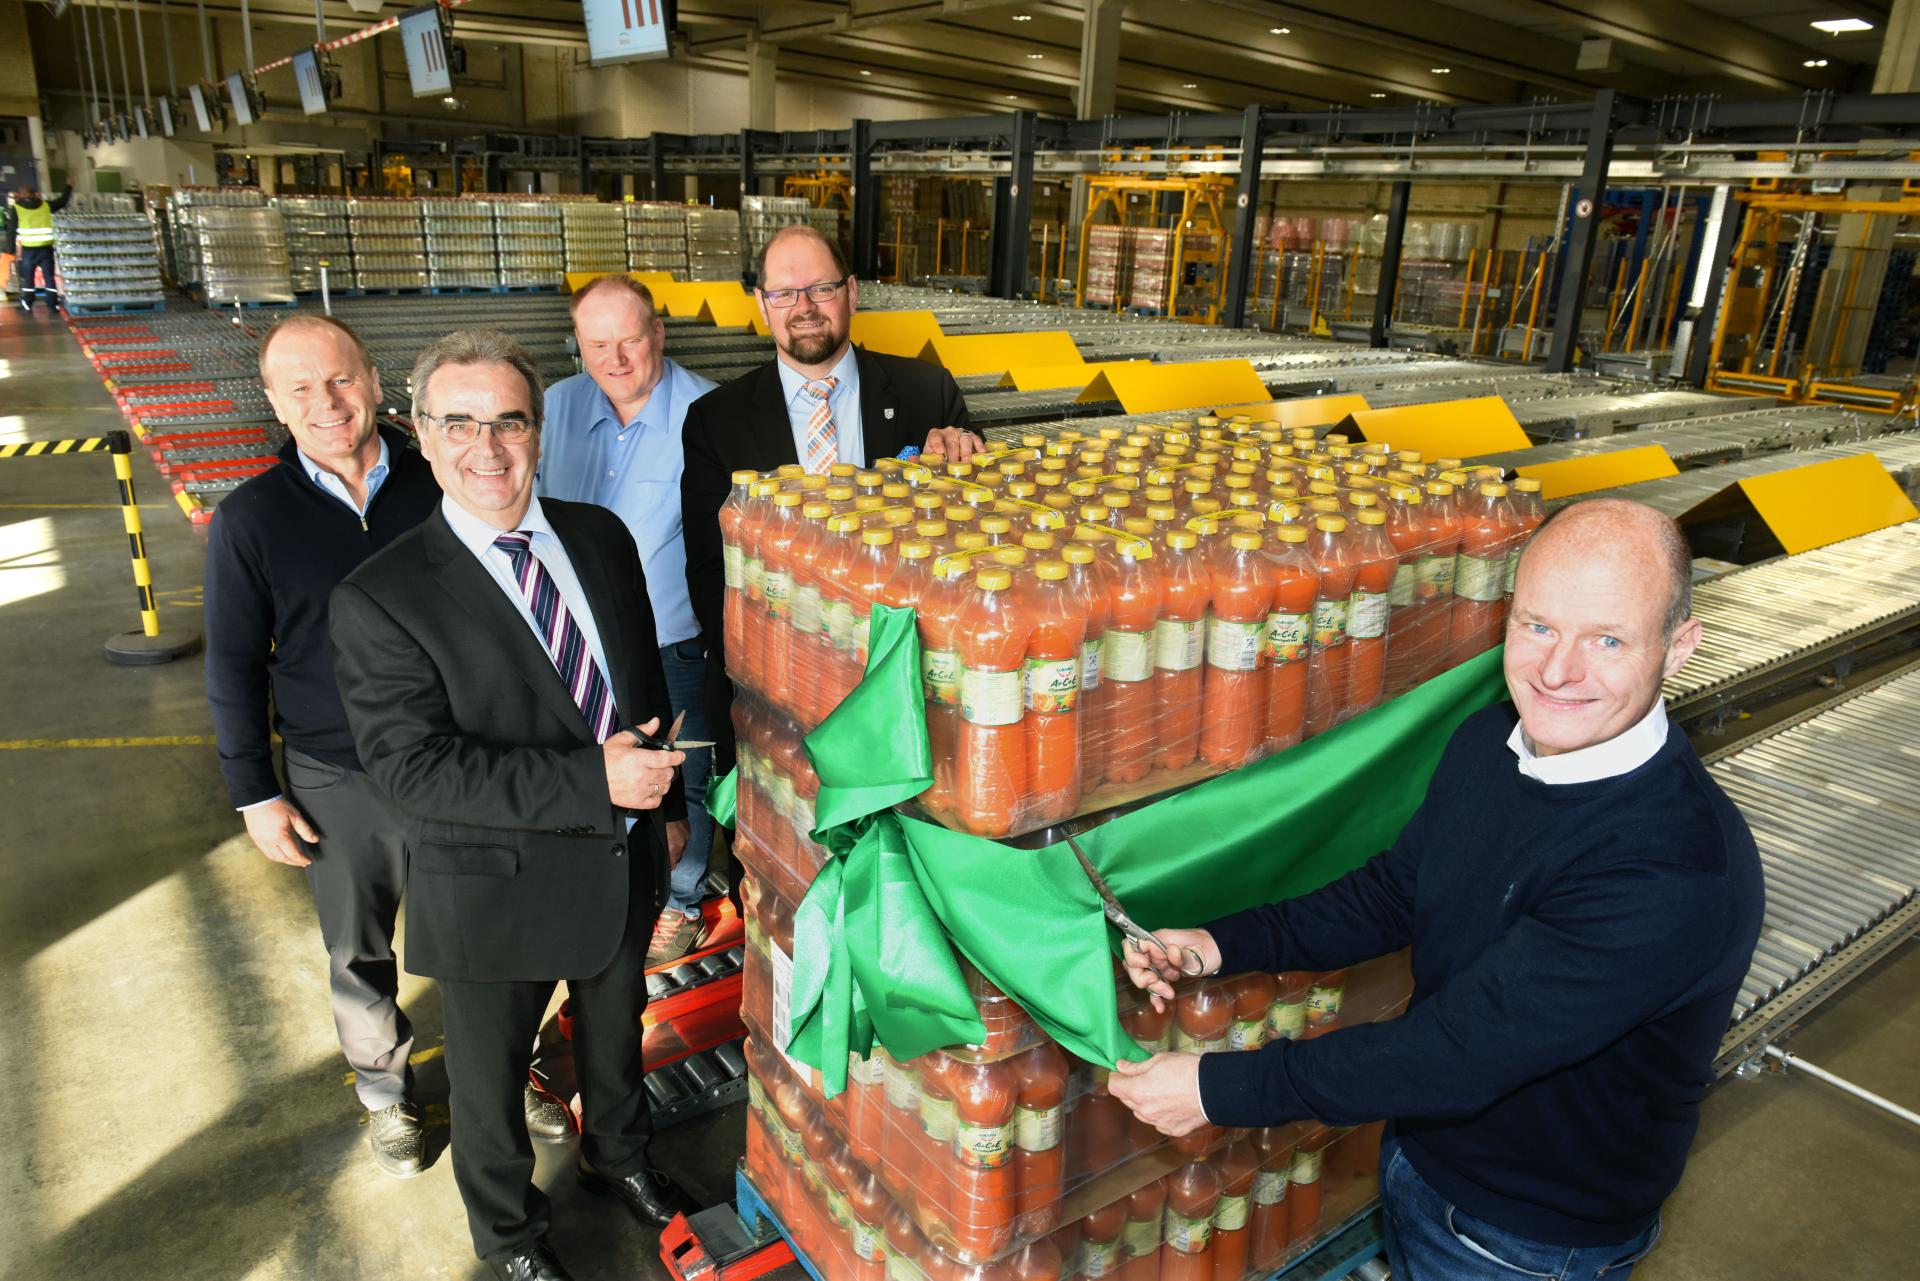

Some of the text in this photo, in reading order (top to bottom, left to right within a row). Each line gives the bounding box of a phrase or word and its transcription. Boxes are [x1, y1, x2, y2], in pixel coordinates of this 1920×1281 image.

[1270, 629, 1299, 638] A+C+E
[926, 669, 956, 680] A+C+E
[1050, 675, 1077, 688] A+C+E
[974, 1140, 1001, 1149] A+C+E
